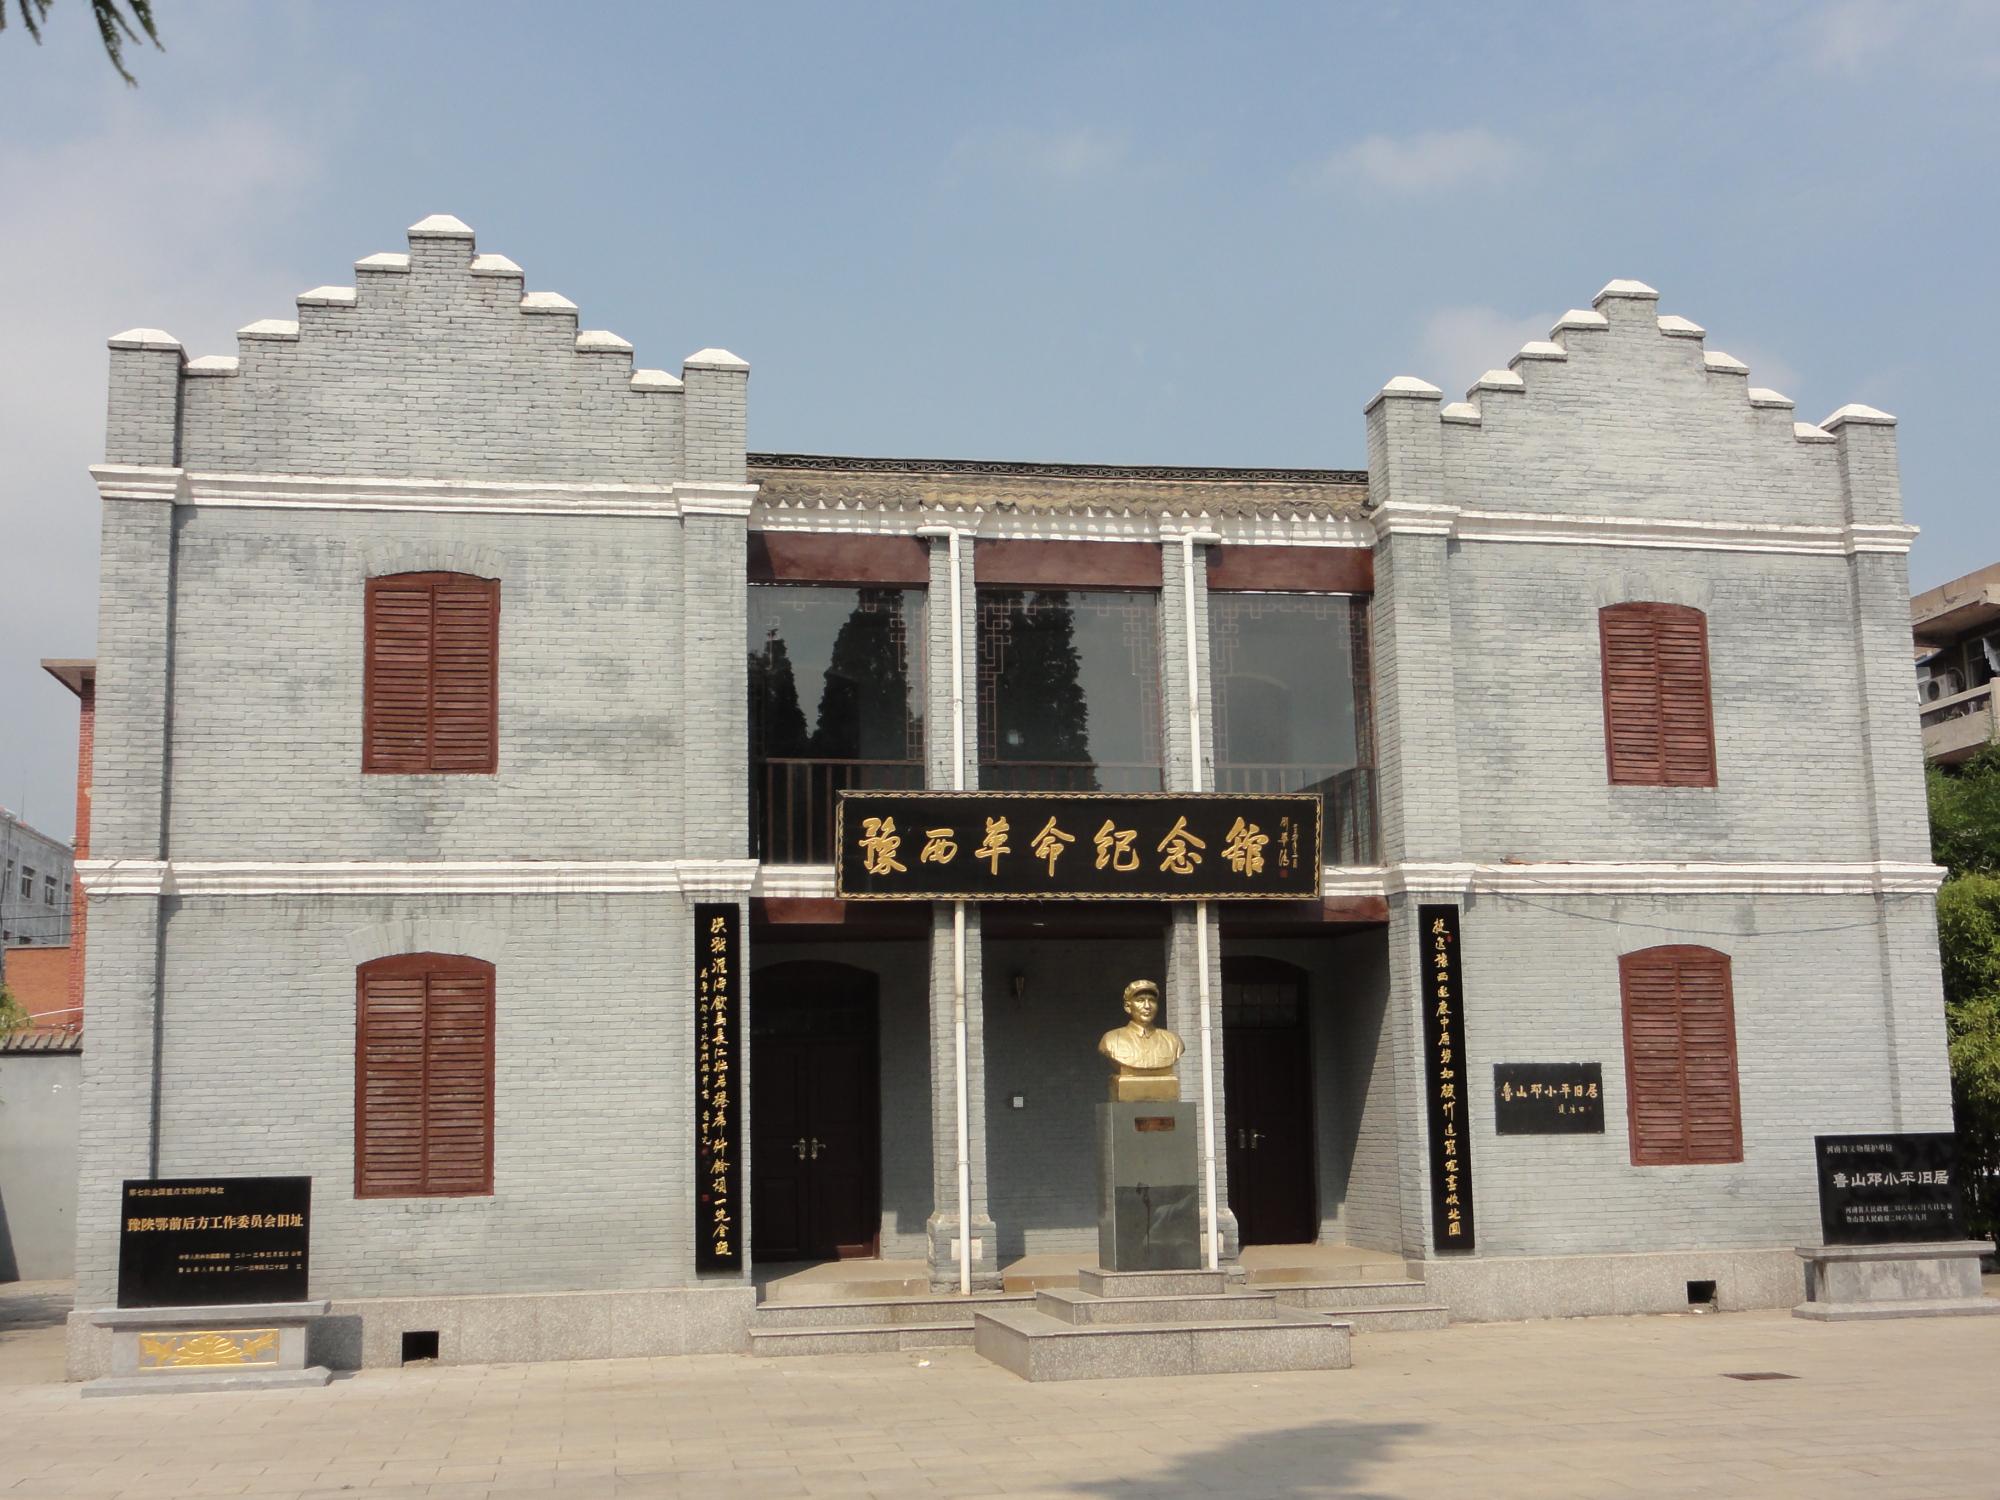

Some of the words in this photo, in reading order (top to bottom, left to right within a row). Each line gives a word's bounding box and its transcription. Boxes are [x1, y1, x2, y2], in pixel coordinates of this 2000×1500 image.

[1833, 1169, 1950, 1189] 鲁山邓小平旧居
[127, 1213, 304, 1232] 豫陕鄂前后方工作委员会旧址
